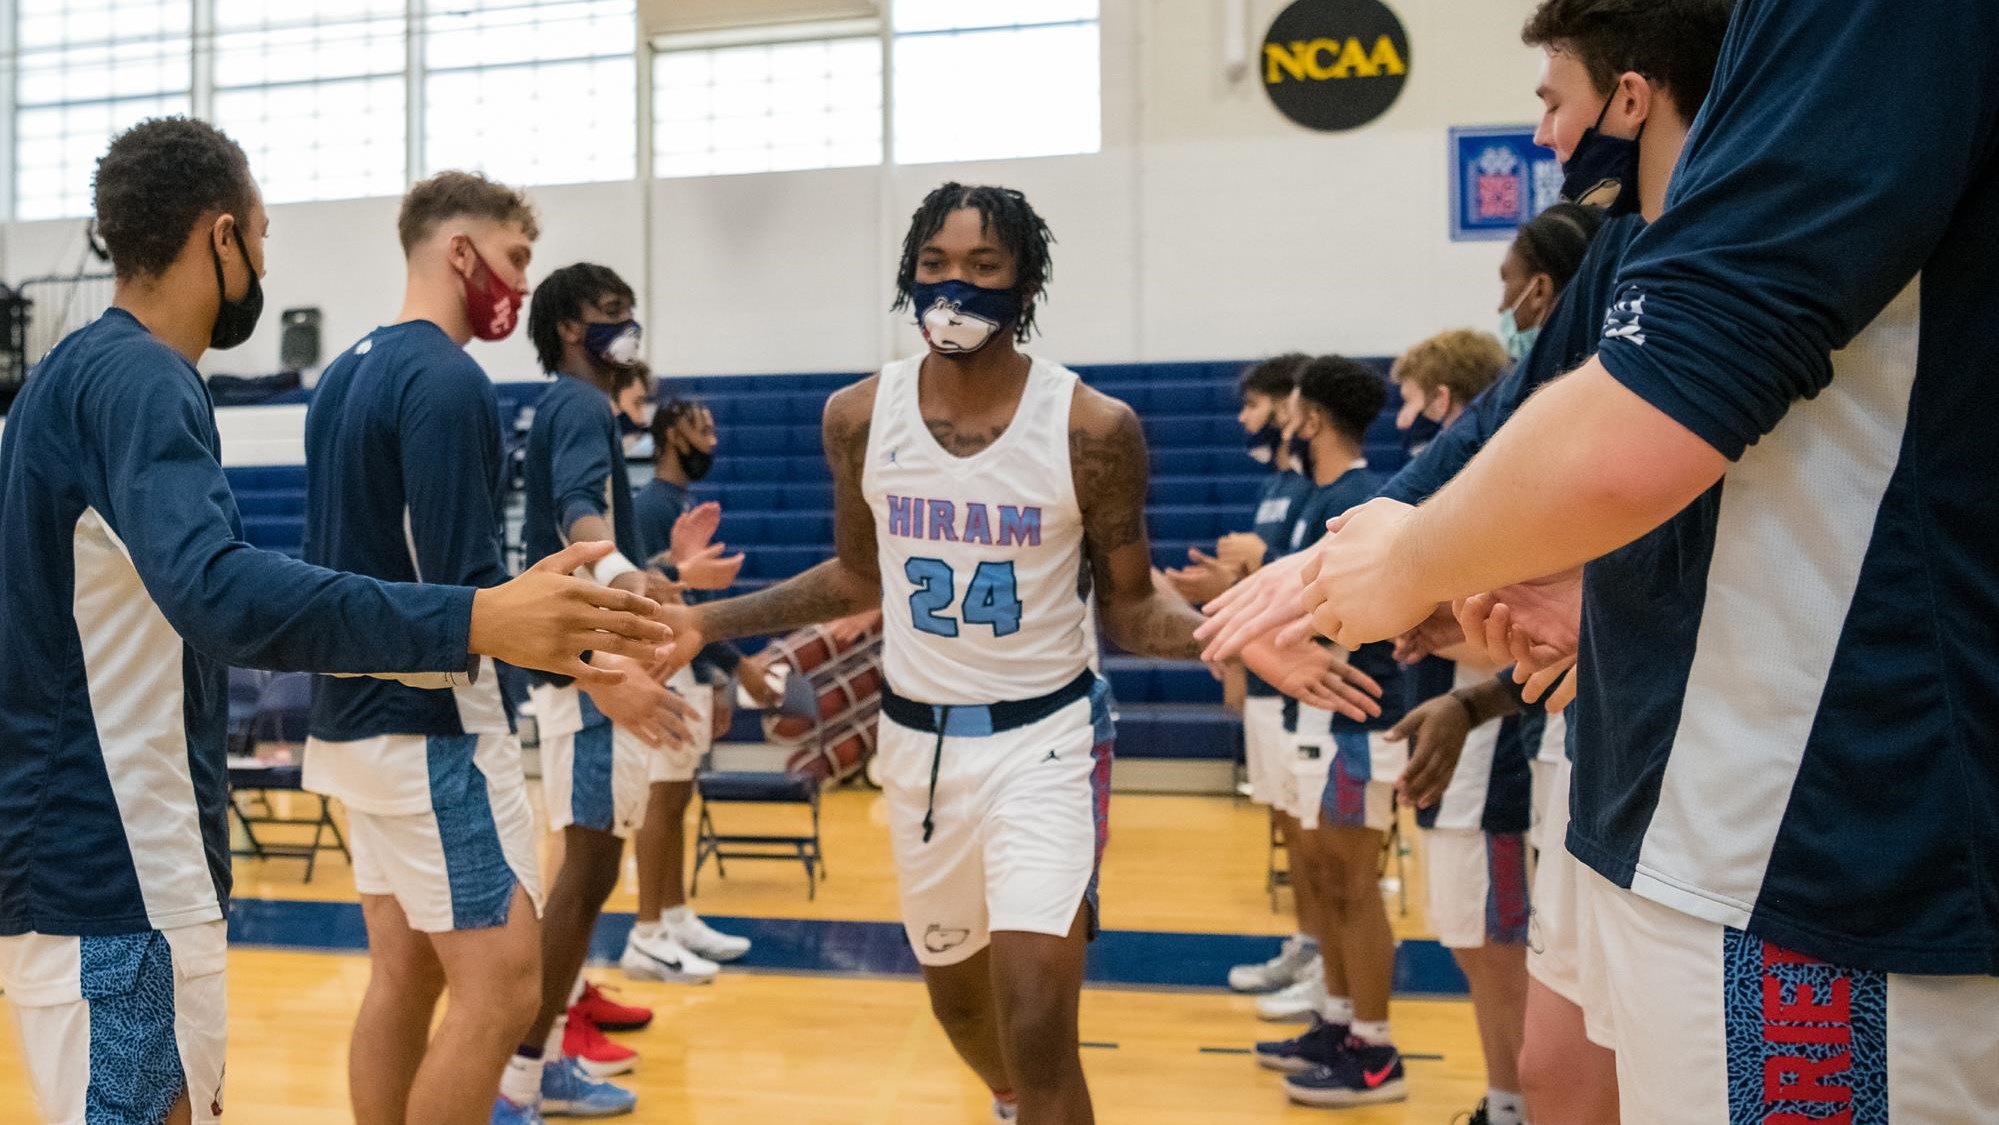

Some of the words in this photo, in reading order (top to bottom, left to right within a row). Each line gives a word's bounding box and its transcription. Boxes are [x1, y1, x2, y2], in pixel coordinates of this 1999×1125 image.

[1264, 34, 1404, 83] NCAA
[886, 494, 1042, 547] HIRAM
[904, 556, 1023, 638] 24
